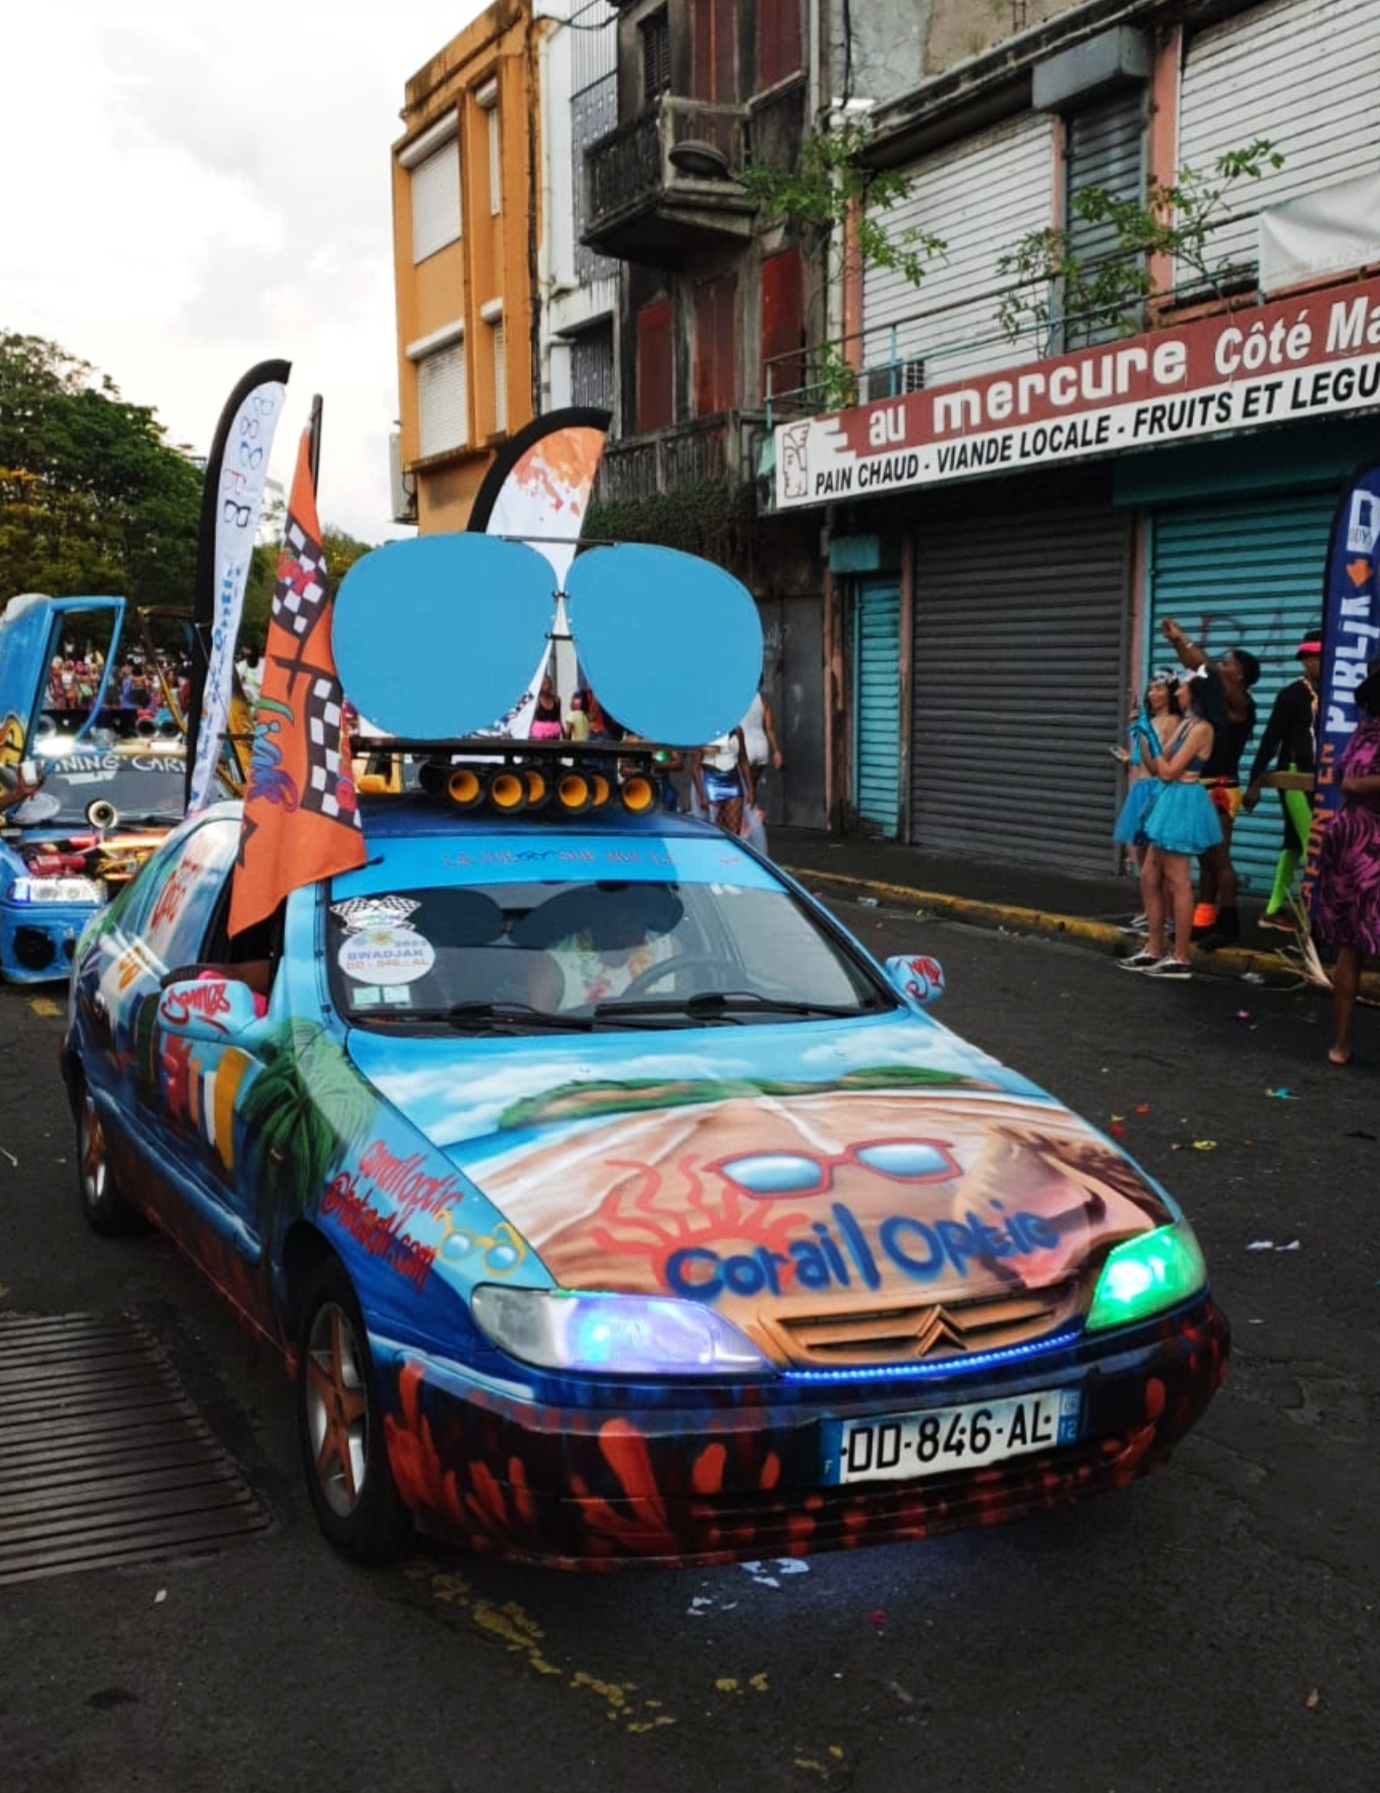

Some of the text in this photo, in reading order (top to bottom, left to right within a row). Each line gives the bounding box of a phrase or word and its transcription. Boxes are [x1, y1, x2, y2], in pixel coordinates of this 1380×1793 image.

[869, 405, 906, 446] au
[933, 340, 1186, 434] mercure
[1215, 309, 1313, 375] Côté
[815, 467, 852, 496] PAIN
[857, 454, 919, 487] CHAUD
[937, 434, 1013, 473] VIANDE
[1019, 414, 1112, 459] LOCALE
[1132, 391, 1234, 438] FRUITS
[1242, 381, 1284, 419] ET
[665, 1202, 882, 1304] Corail
